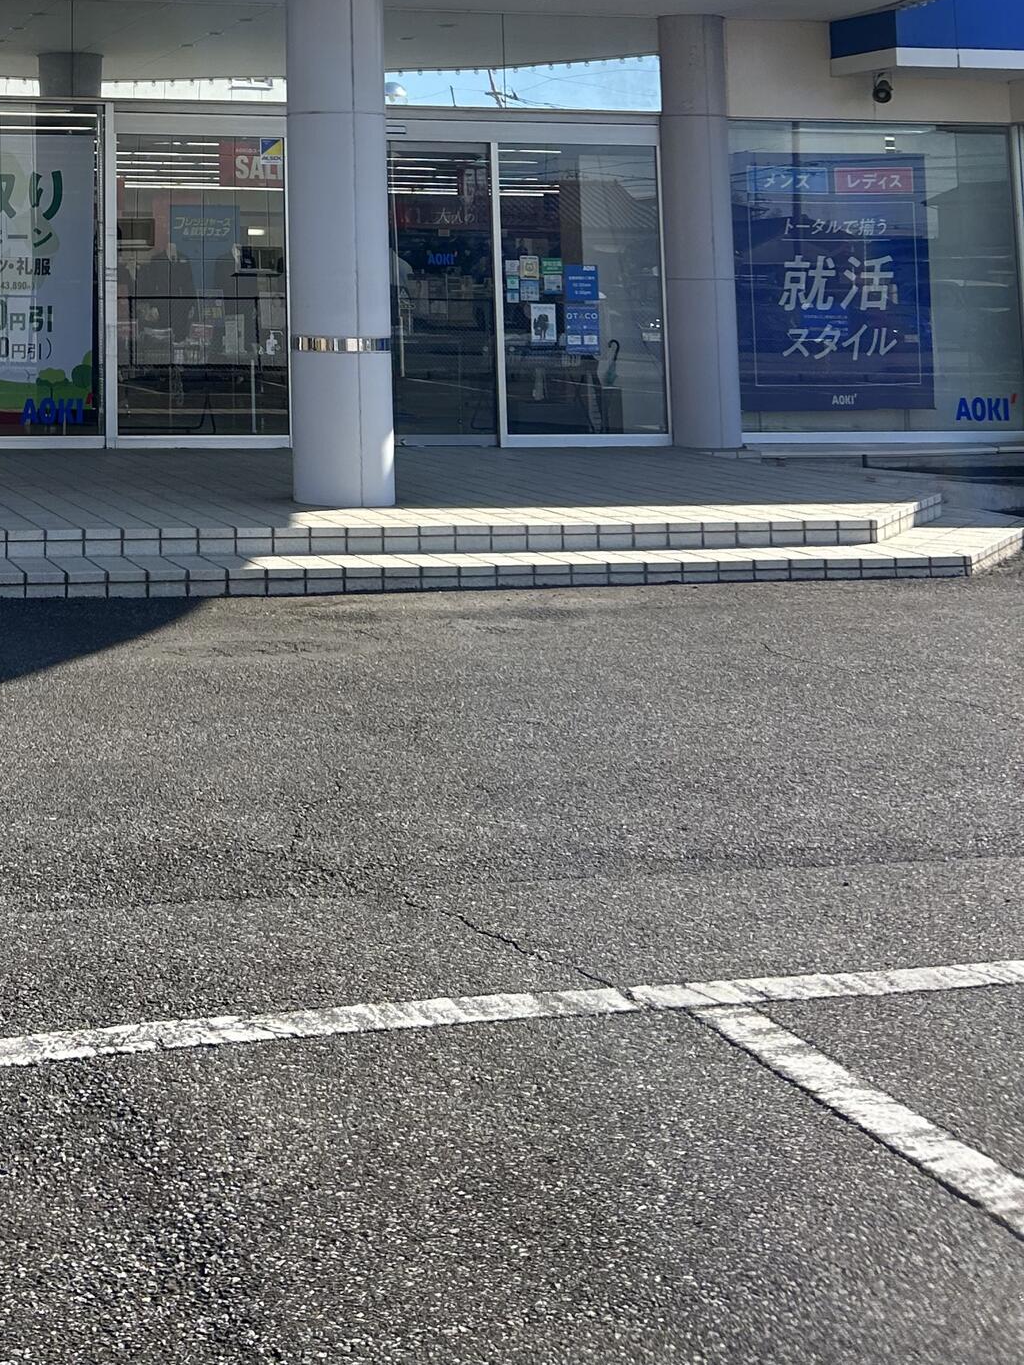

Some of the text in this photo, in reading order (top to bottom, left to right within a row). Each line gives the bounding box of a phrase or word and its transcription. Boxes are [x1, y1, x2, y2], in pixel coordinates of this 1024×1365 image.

[763, 173, 810, 189] メンズ
[847, 173, 902, 189] レディス
[783, 217, 888, 236] トータルで揃う
[428, 252, 455, 265] AOKI
[778, 254, 896, 312] 就活
[782, 324, 898, 361] スタイル
[831, 395, 855, 405] AOKI
[956, 397, 1010, 421] AOKI
[21, 397, 84, 425] AOKI
